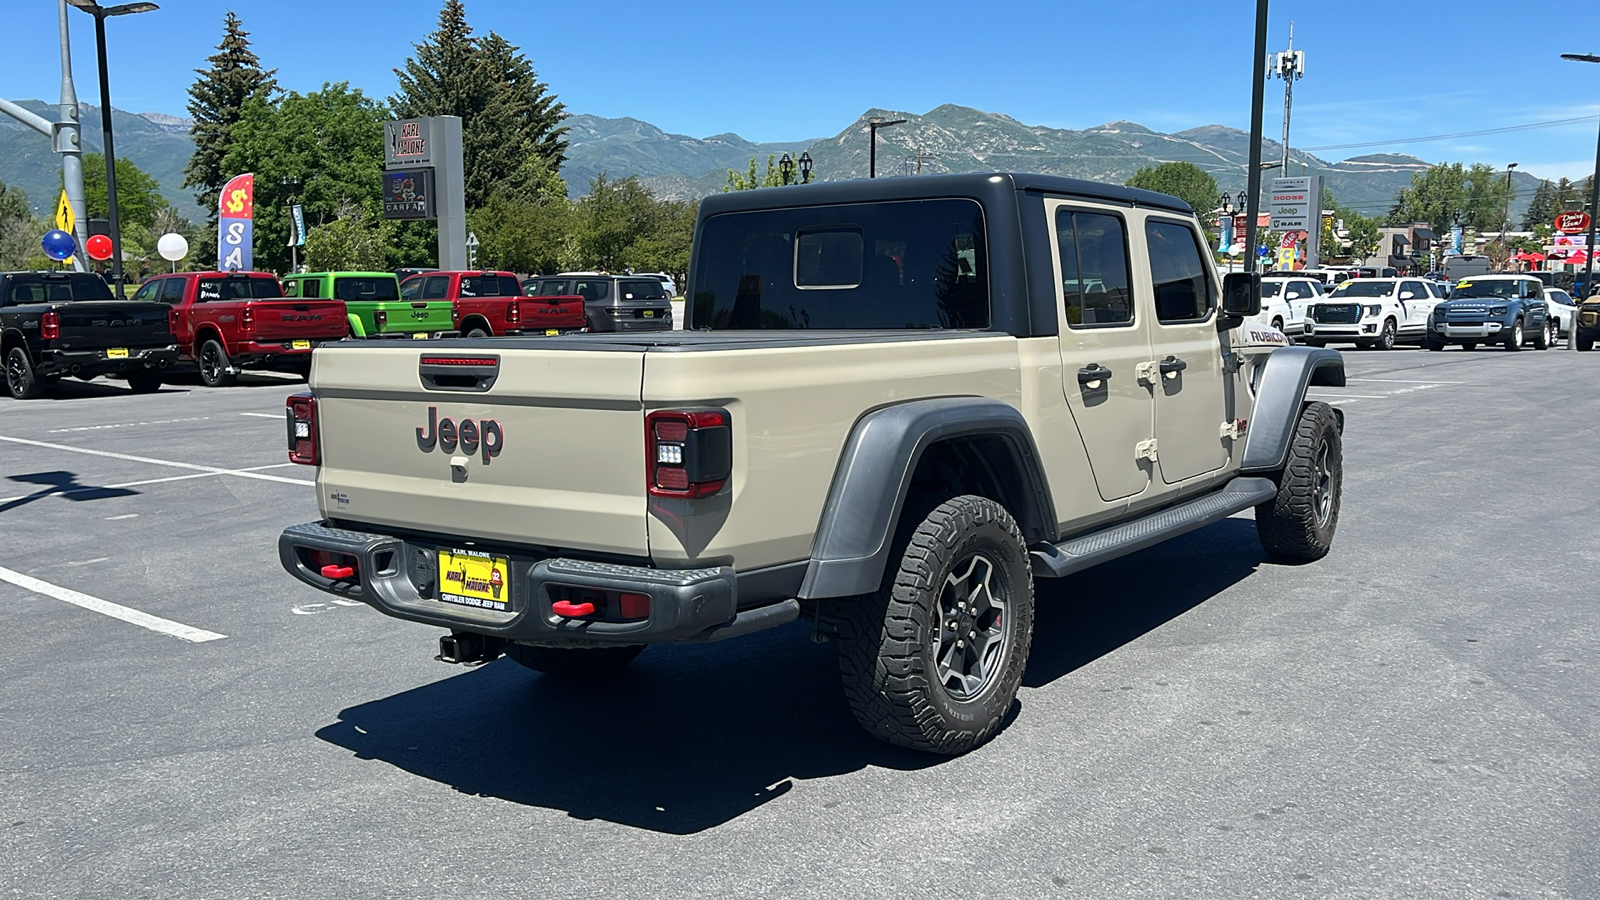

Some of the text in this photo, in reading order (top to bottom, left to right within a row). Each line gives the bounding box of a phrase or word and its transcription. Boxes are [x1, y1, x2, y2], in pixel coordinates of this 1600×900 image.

[401, 123, 420, 138] KARL
[397, 139, 425, 156] MALONE
[386, 202, 425, 211] CARFAX
[1278, 206, 1298, 215] Jeep
[1562, 213, 1583, 224] Dairy
[1282, 232, 1297, 247] USED
[281, 314, 323, 322] RAM
[411, 311, 429, 319] Jeep
[91, 319, 143, 327] RAM
[1250, 331, 1288, 344] RUBICON
[415, 406, 504, 463] Jeep
[452, 548, 490, 558] KARL MALONE
[446, 570, 462, 582] KARL
[492, 572, 500, 581] 32
[465, 580, 490, 593] MALONE
[442, 593, 505, 610] CHRYSLER DODGE JEEP RAM
